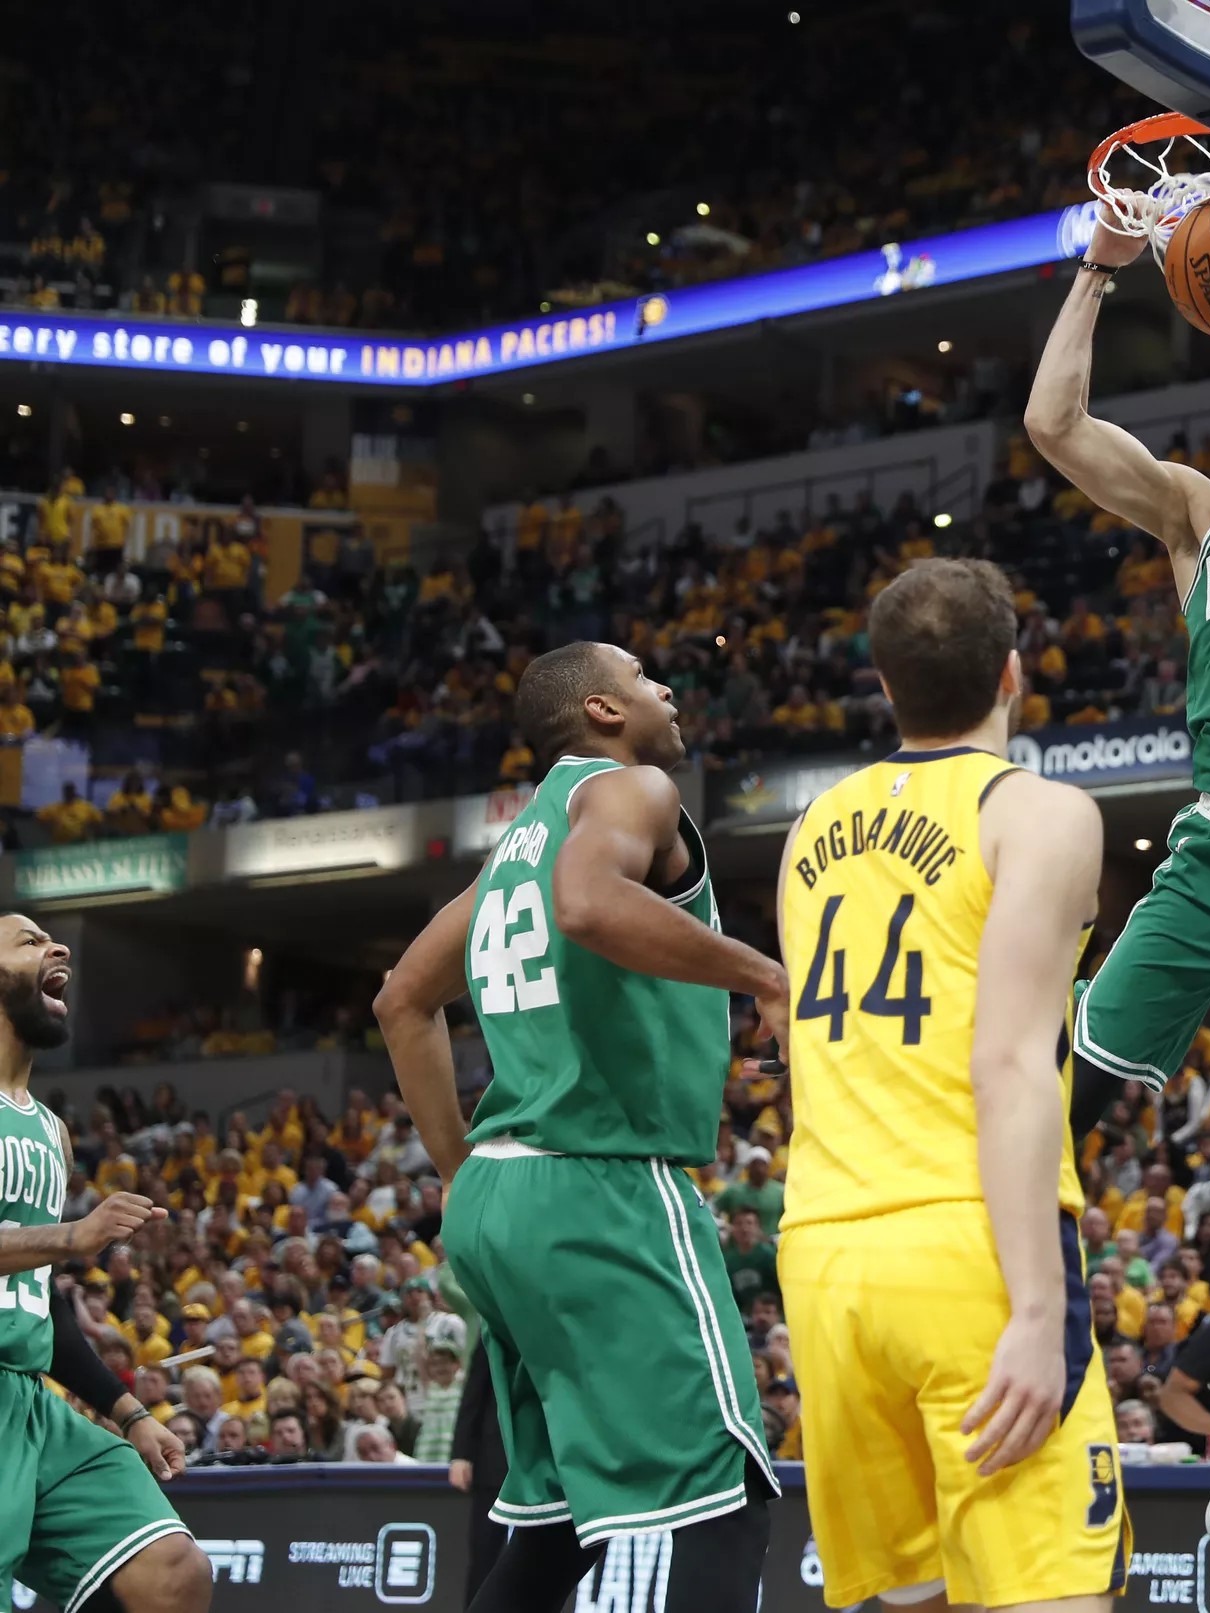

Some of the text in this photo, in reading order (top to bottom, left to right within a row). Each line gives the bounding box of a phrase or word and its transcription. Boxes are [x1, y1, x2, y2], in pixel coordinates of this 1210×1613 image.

[92, 328, 194, 365] store
[208, 336, 248, 368] of
[260, 343, 347, 375] your
[360, 335, 493, 379] INDIANA
[501, 311, 617, 363] PACERS!
[1043, 726, 1191, 777] motorola
[470, 880, 561, 1015] 42
[796, 894, 932, 1046] 44
[288, 1541, 376, 1564] STREAMING
[338, 1565, 375, 1588] LIVE
[1149, 1579, 1196, 1604] LIVE
